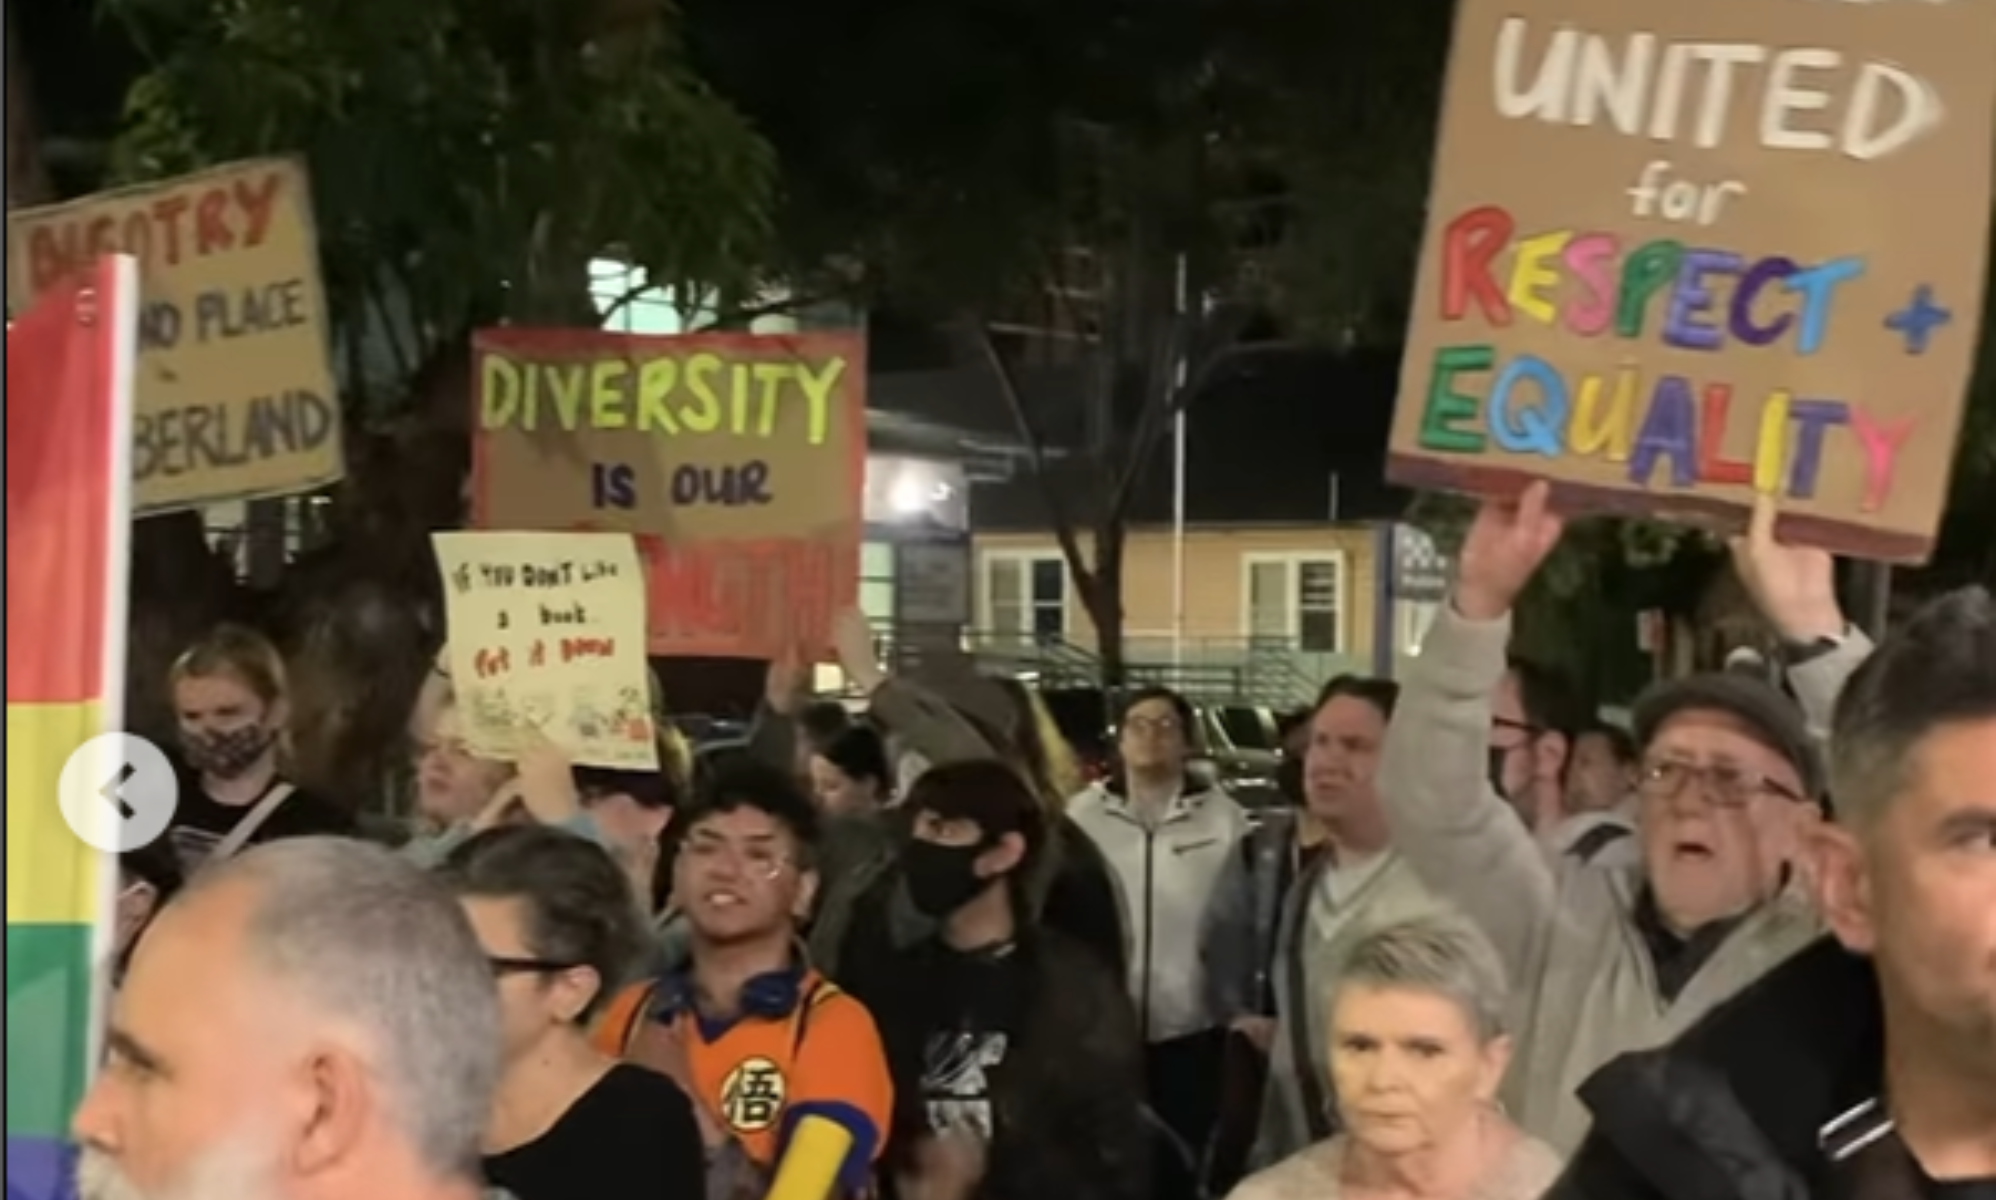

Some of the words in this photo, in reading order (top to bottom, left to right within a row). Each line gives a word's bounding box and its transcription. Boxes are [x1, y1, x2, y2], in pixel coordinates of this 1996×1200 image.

[1491, 17, 1943, 160] UNITED
[1625, 160, 1749, 226] for
[194, 277, 308, 344] PLACE
[1438, 205, 1868, 356] RESPECT
[479, 352, 846, 445] DIVERSITY
[1418, 344, 1916, 513] EQUALITY
[591, 462, 636, 509] IS
[669, 459, 774, 506] OUR
[726, 1070, 779, 1123] 悟
